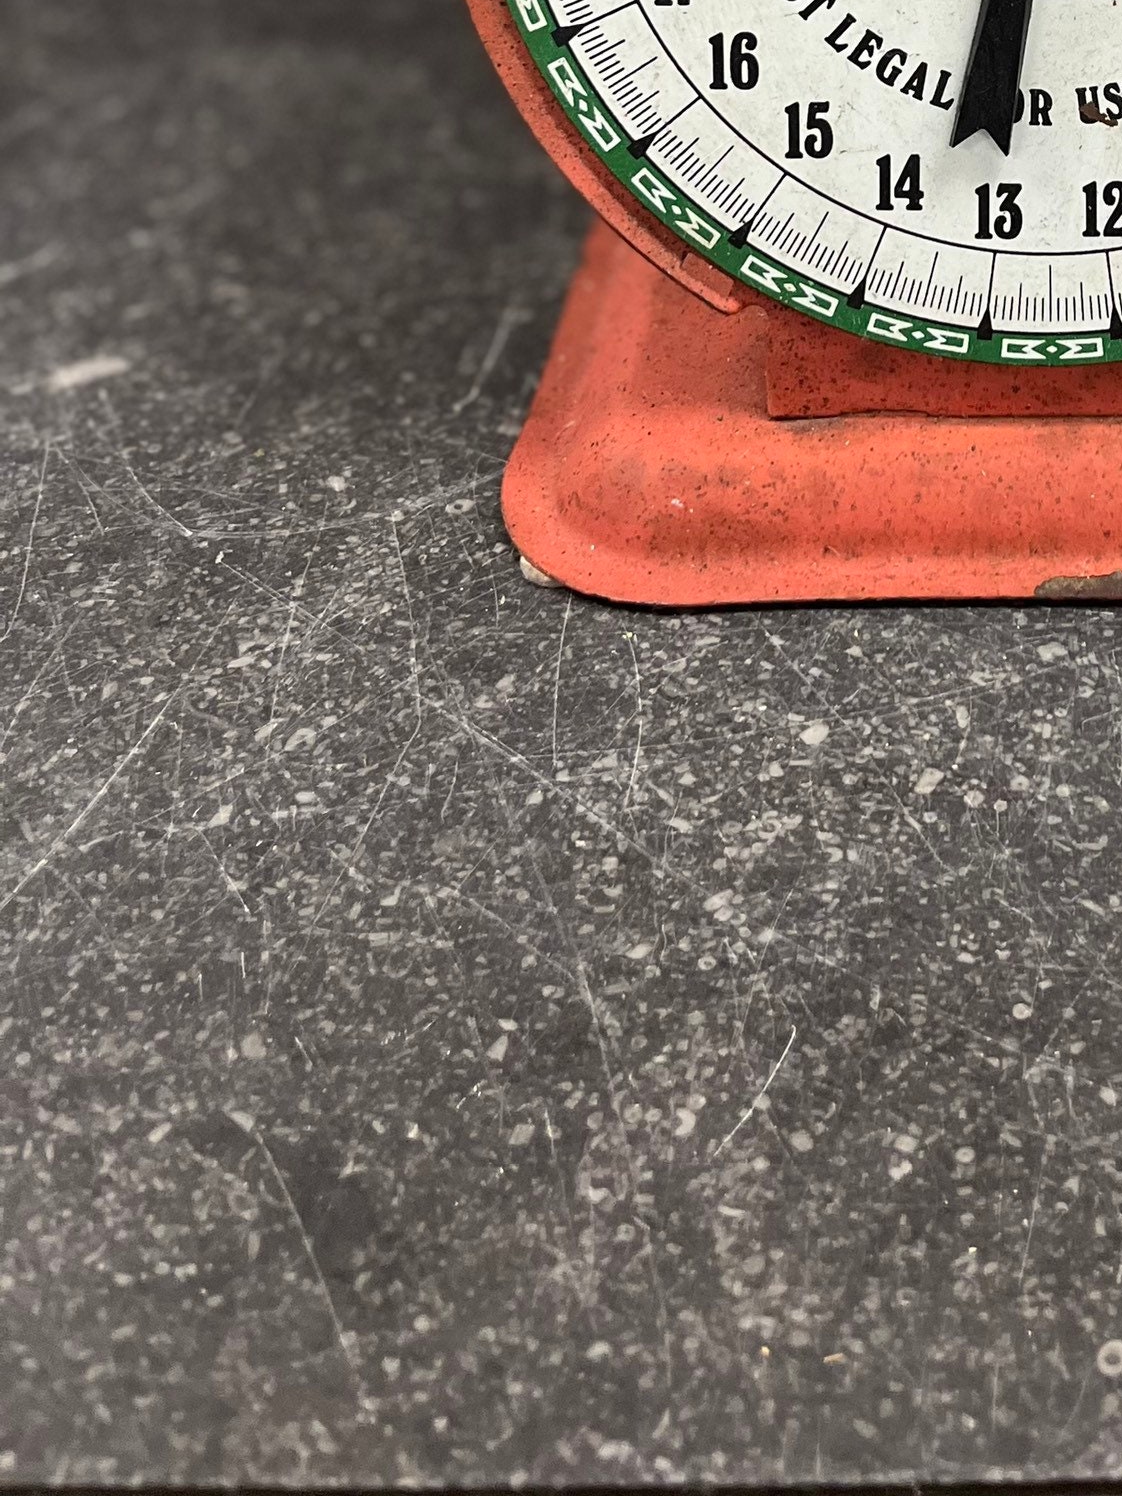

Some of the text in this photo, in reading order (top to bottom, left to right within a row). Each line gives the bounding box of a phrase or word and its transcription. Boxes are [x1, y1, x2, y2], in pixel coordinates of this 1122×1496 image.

[709, 32, 759, 91] 16
[824, 13, 955, 111] LEGAL
[785, 101, 833, 159] 15
[876, 154, 924, 211] 14
[975, 183, 1022, 240] 13
